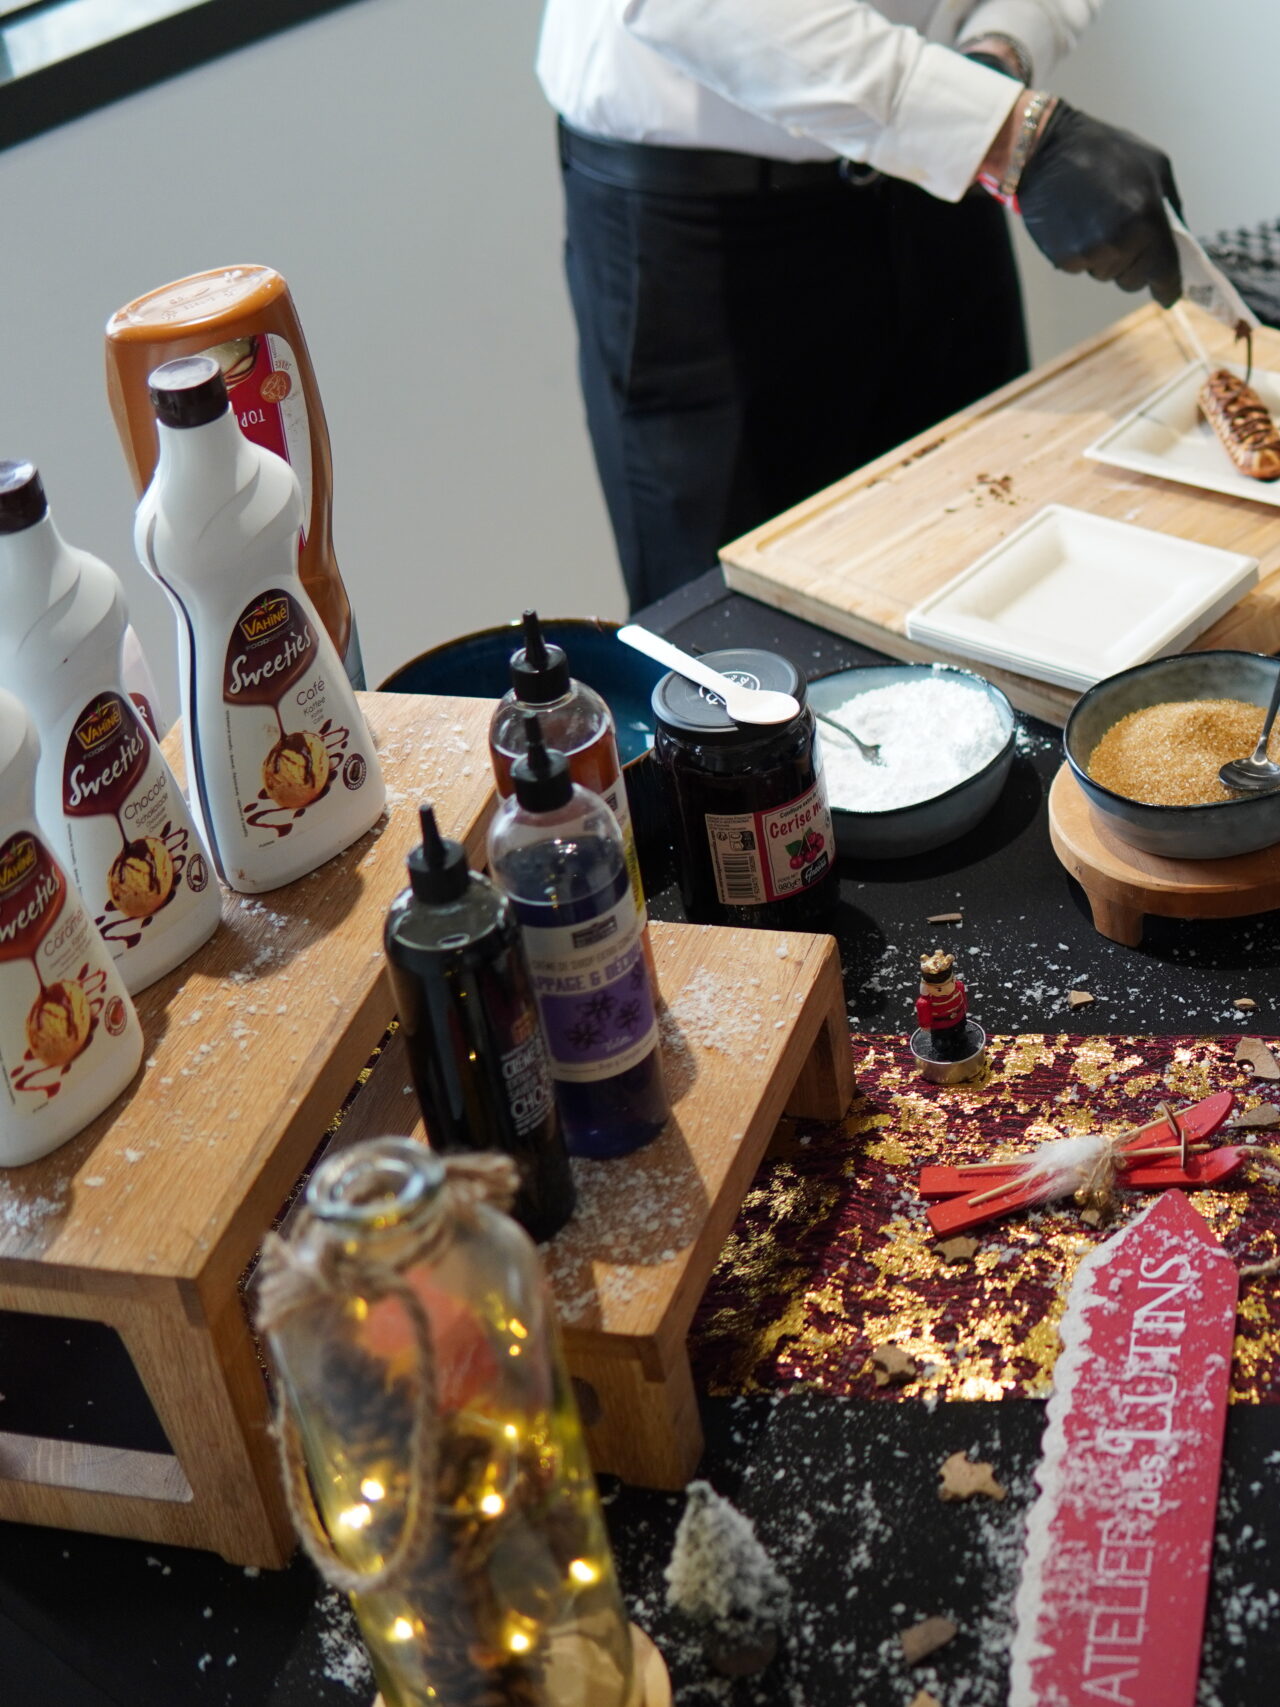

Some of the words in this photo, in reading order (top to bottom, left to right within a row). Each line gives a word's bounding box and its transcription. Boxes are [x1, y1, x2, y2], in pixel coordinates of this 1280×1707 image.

[235, 408, 266, 428] TOP
[296, 675, 325, 706] Café
[69, 726, 144, 807] Sweeties
[769, 809, 812, 839] Cerise
[0, 865, 60, 943] weeties
[1095, 1254, 1192, 1455] LUTINS
[1127, 1453, 1168, 1511] des
[1080, 1513, 1156, 1707] ATELIER
